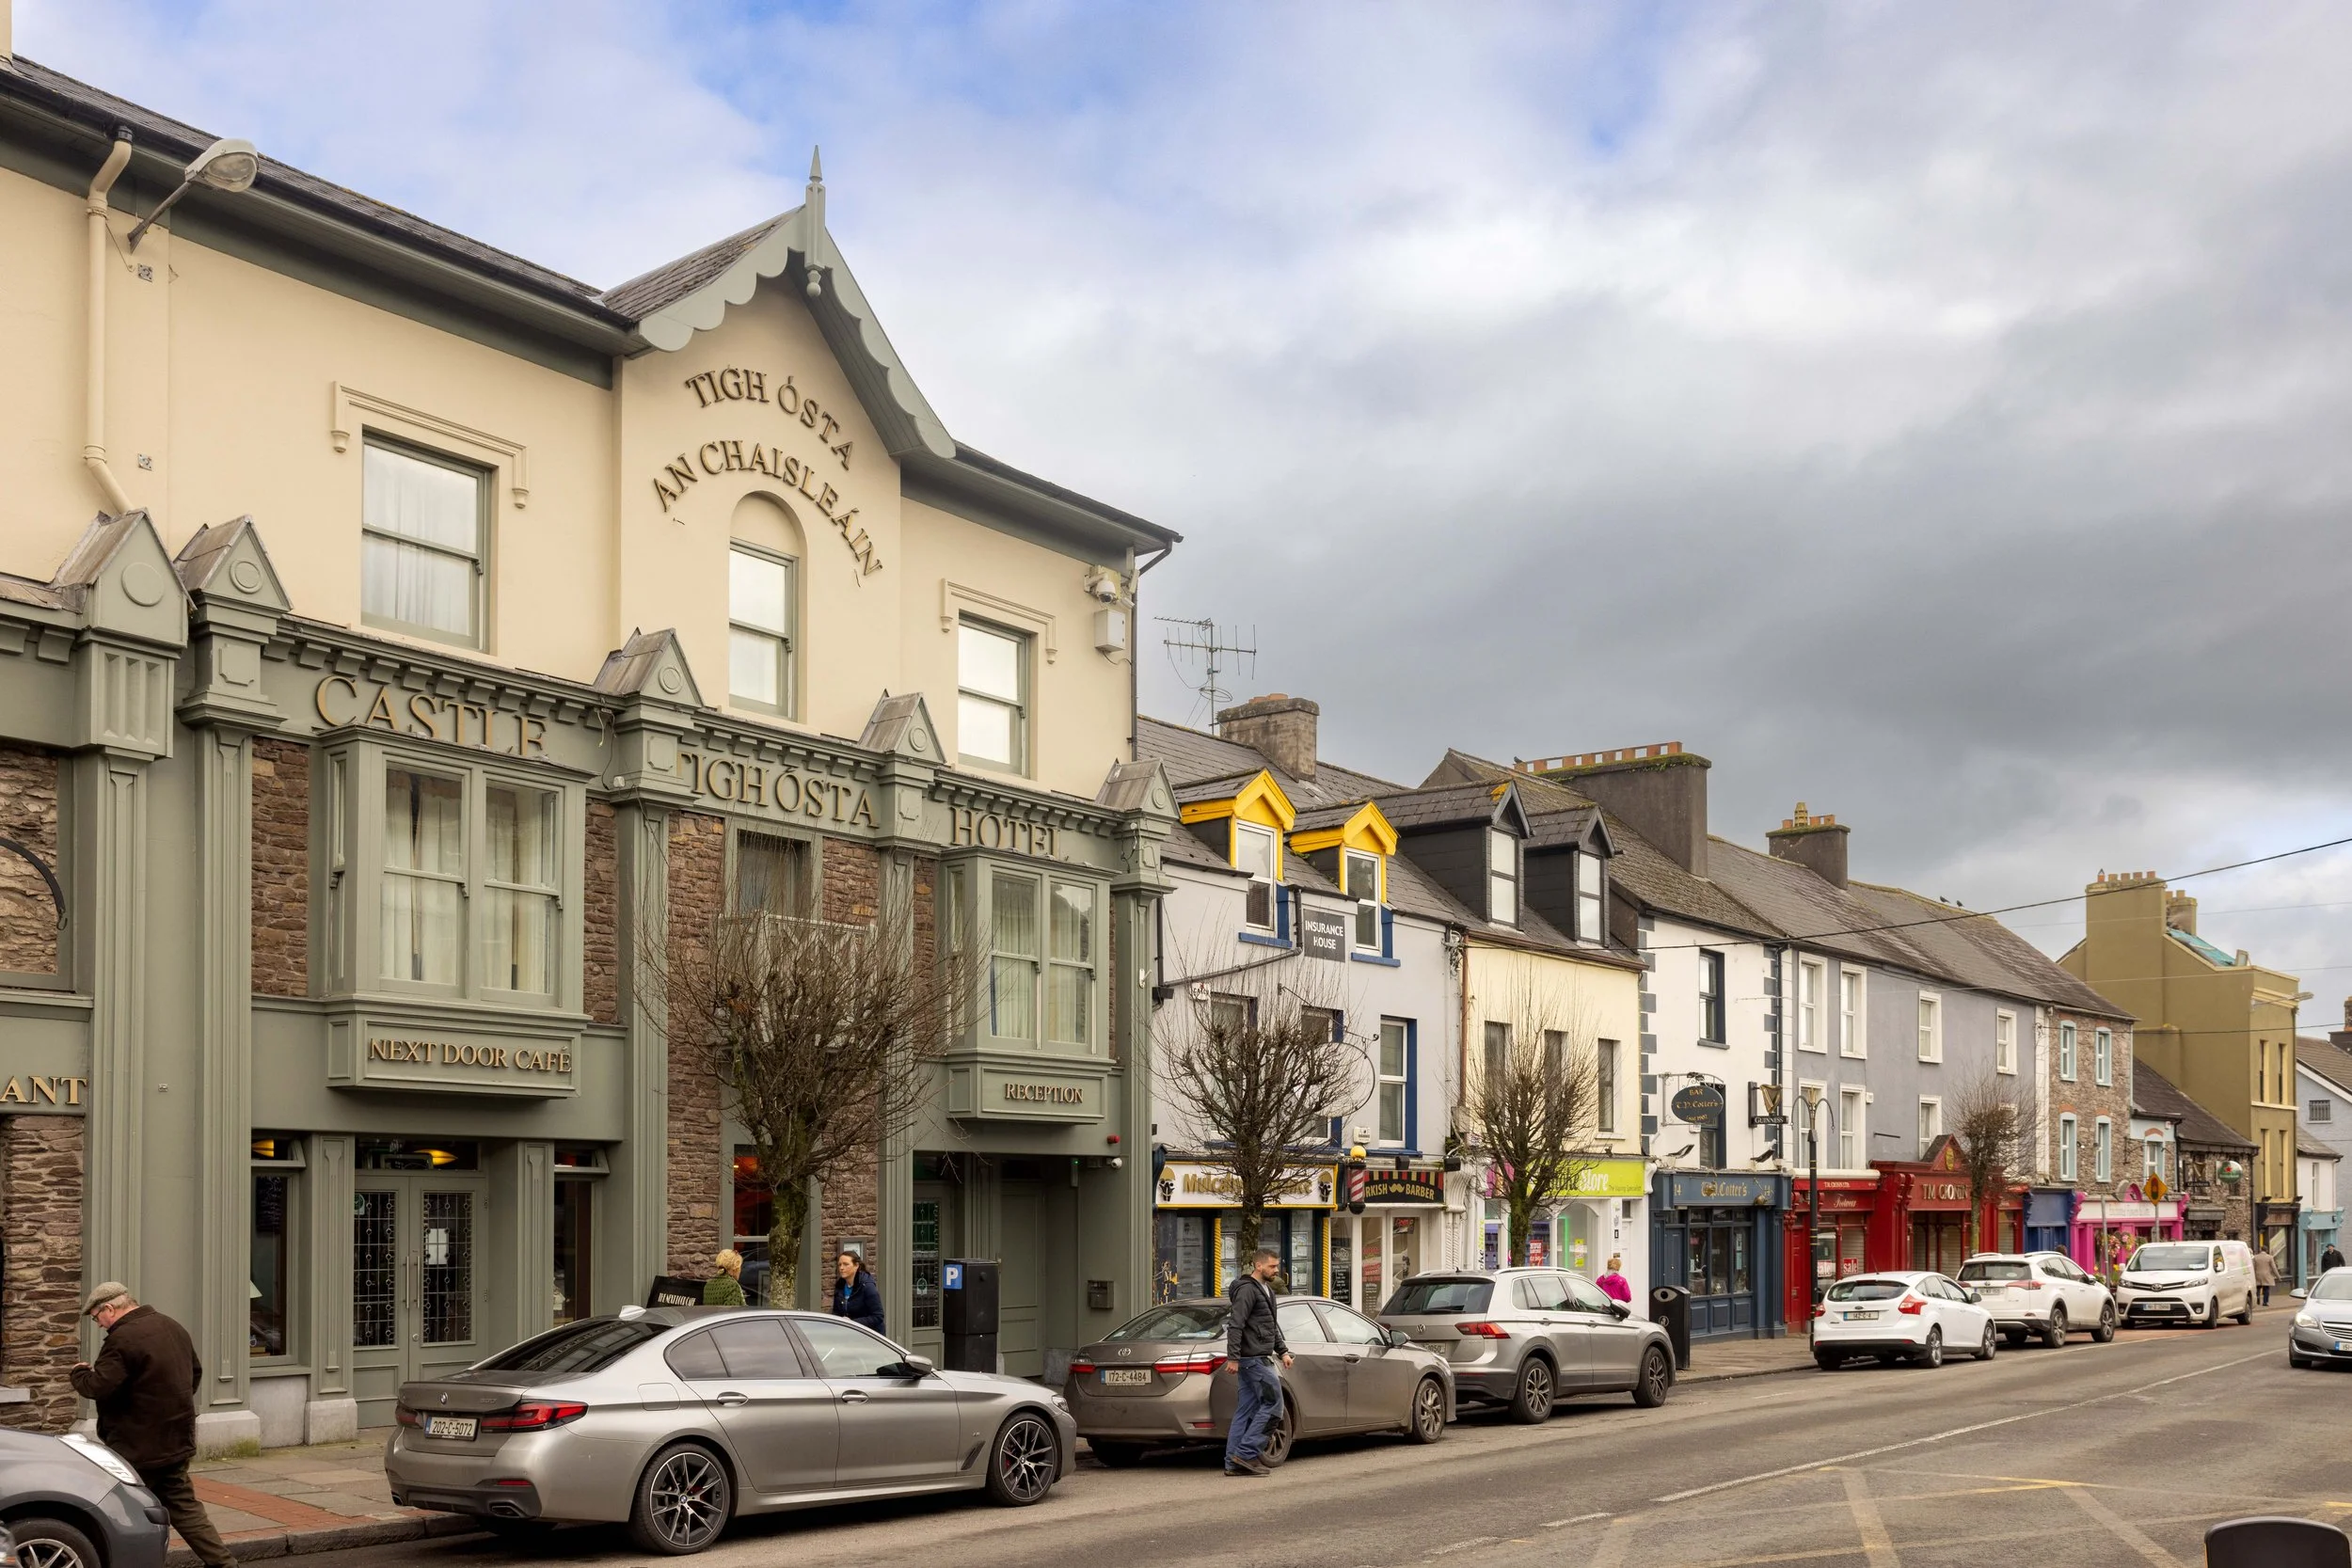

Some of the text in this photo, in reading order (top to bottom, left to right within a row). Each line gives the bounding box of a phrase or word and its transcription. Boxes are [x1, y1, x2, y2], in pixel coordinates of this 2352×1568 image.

[685, 368, 853, 470] TIGH ÓSTA
[653, 440, 882, 577] AN CHAISLEÁIN
[315, 675, 548, 756] CASTLE
[677, 752, 881, 830] TIGH ÓSTA
[949, 806, 1070, 860] HOTEL
[1305, 920, 1344, 937] INSURANCE
[1313, 936, 1337, 950] HOUSE
[369, 1037, 573, 1073] NEXT DOOR CAFÉ
[0, 1075, 88, 1105] ANT
[1004, 1083, 1085, 1104] RECEPTION
[1755, 1116, 1784, 1124] GUINNESS
[1580, 1168, 1609, 1192] Store
[1365, 1183, 1435, 1201] RKISH BARBER
[1922, 1183, 1968, 1200] TM CRONIN
[946, 1267, 959, 1286] P
[1844, 1259, 1858, 1274] sale
[1109, 1372, 1147, 1385] 172-C-4484
[432, 1420, 473, 1436] 202-C-5072
